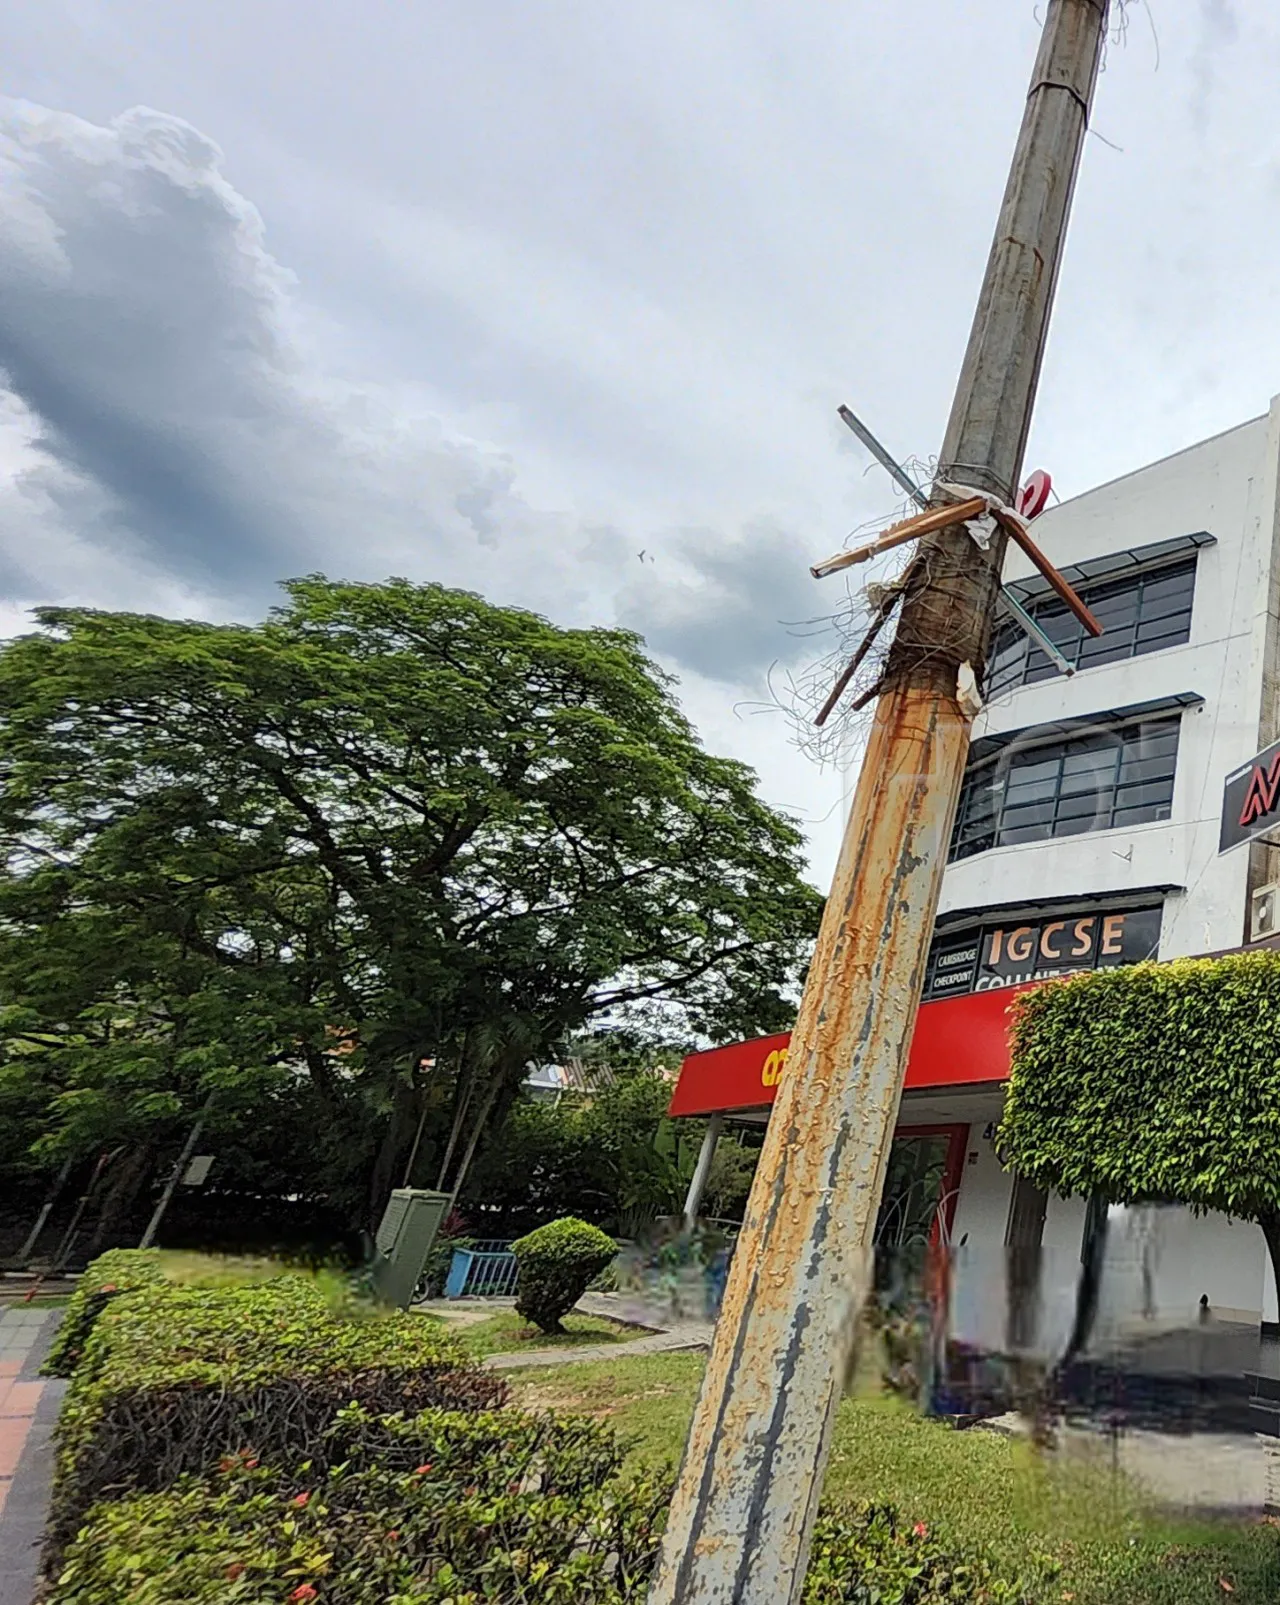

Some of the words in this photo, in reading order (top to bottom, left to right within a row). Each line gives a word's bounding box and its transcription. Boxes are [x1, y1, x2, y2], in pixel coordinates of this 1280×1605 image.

[988, 915, 1127, 965] IGCSE
[938, 948, 977, 968] CAMBRIDGE
[934, 970, 973, 988] CHECKPOINT
